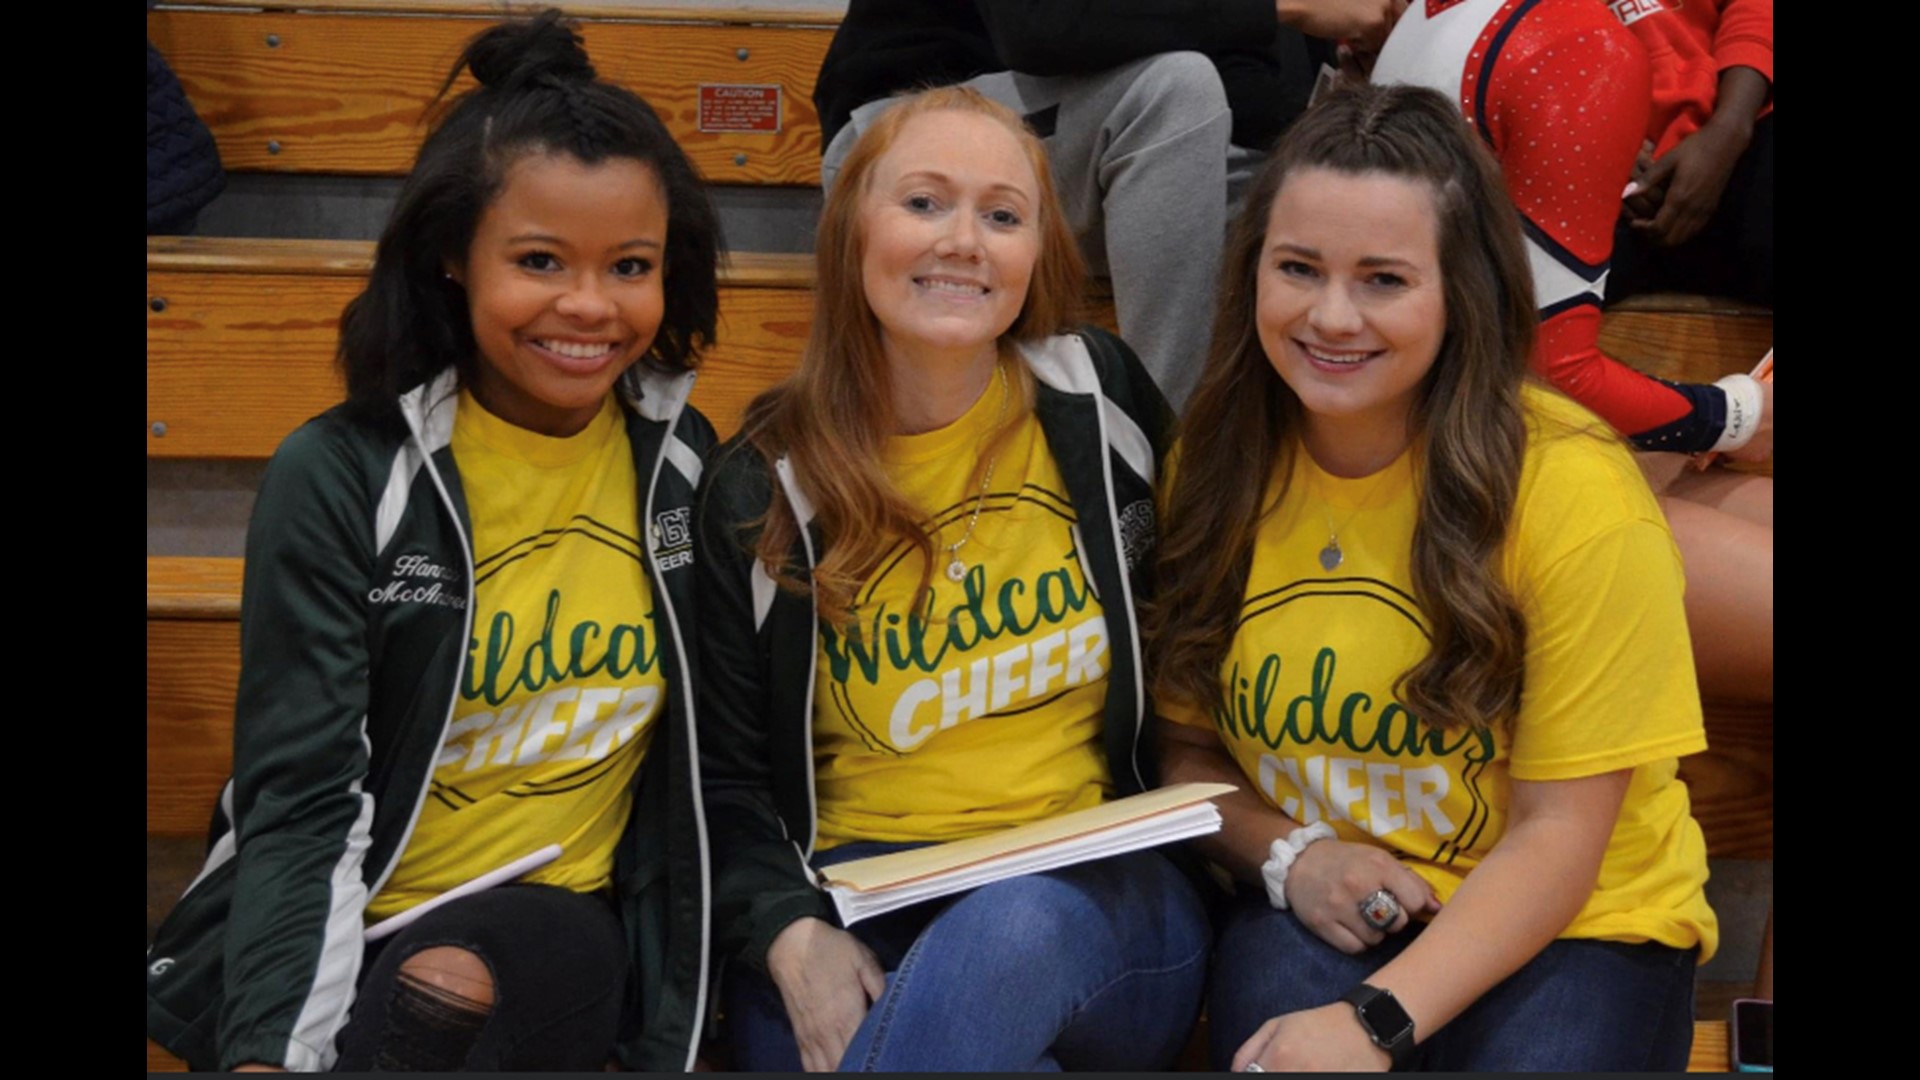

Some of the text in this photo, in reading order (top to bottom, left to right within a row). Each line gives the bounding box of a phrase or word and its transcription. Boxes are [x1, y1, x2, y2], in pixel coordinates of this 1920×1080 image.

[714, 88, 764, 98] CAUTION
[818, 546, 1090, 685] Wildca
[1257, 752, 1456, 837] CHEER
